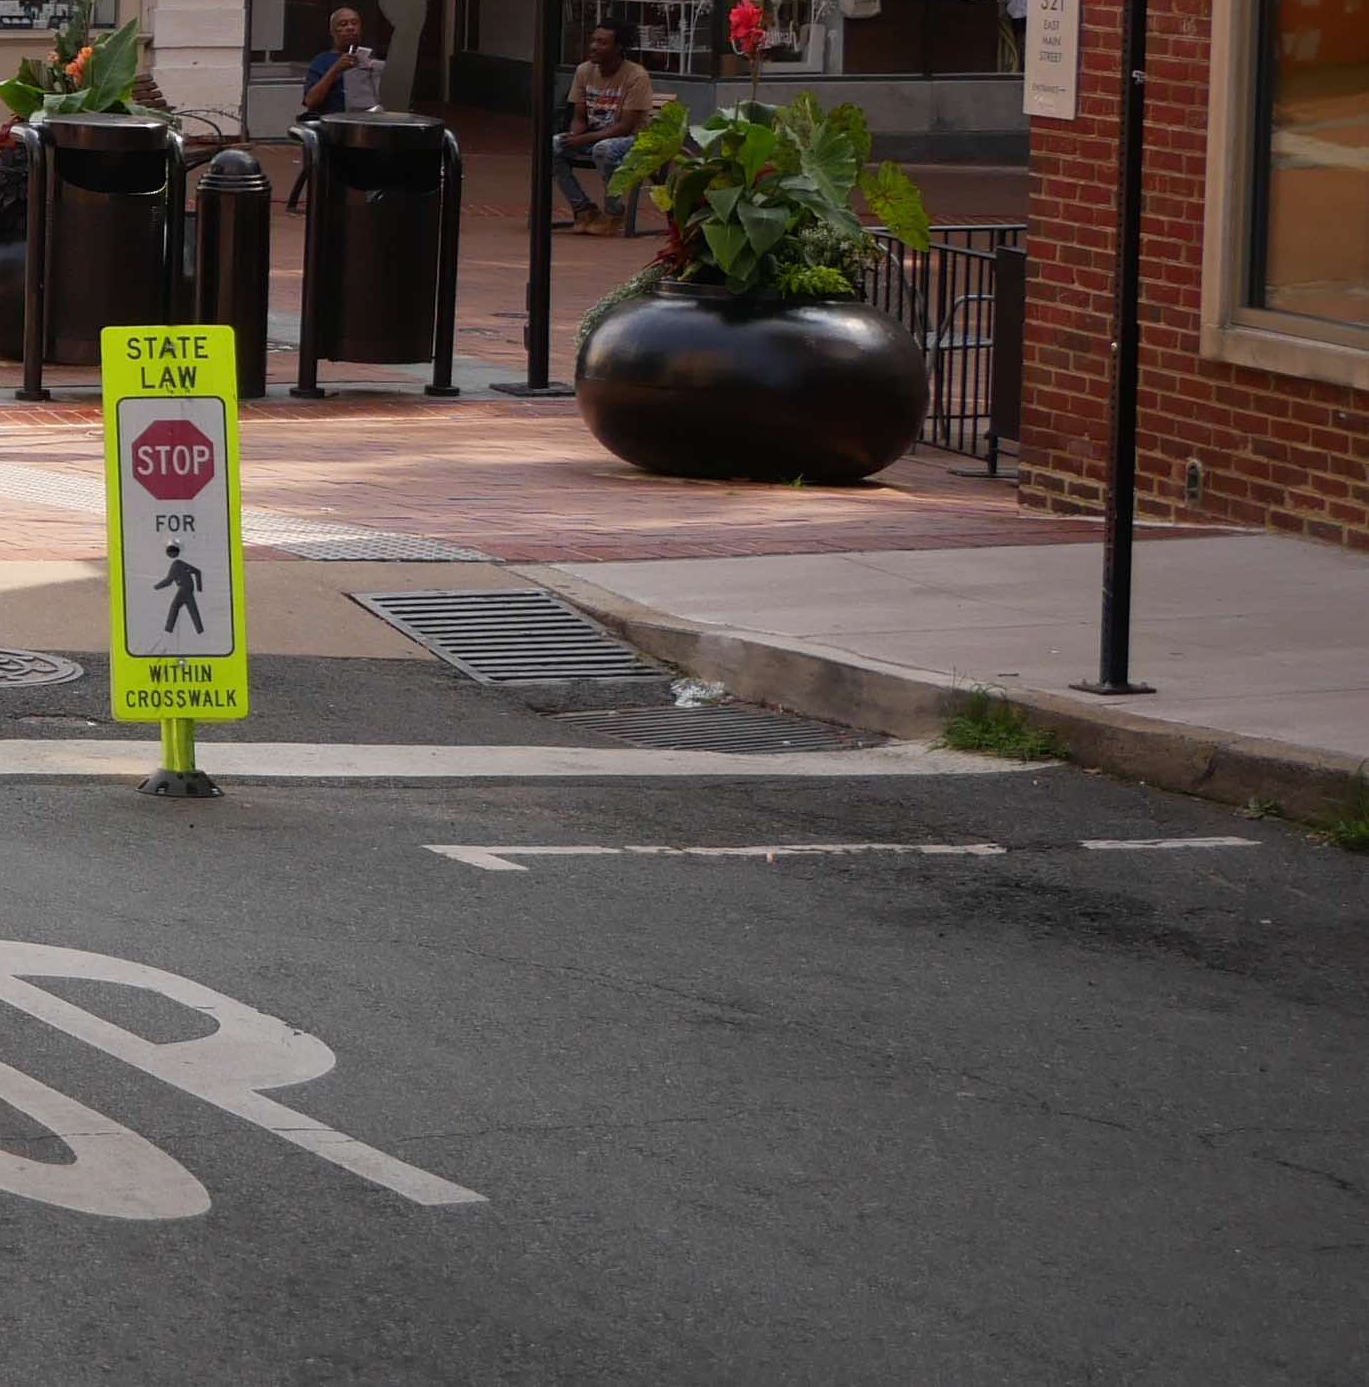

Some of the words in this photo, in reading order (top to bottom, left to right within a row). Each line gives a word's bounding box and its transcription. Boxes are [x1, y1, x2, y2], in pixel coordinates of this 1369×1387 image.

[1043, 19, 1060, 30] EAST
[1042, 37, 1062, 46] MAIN
[126, 336, 209, 360] STATE
[141, 366, 197, 390] LAW
[137, 445, 210, 476] STOP
[156, 515, 196, 533] FOR
[149, 663, 212, 683] WITHIN
[126, 689, 238, 709] CROSSWALK
